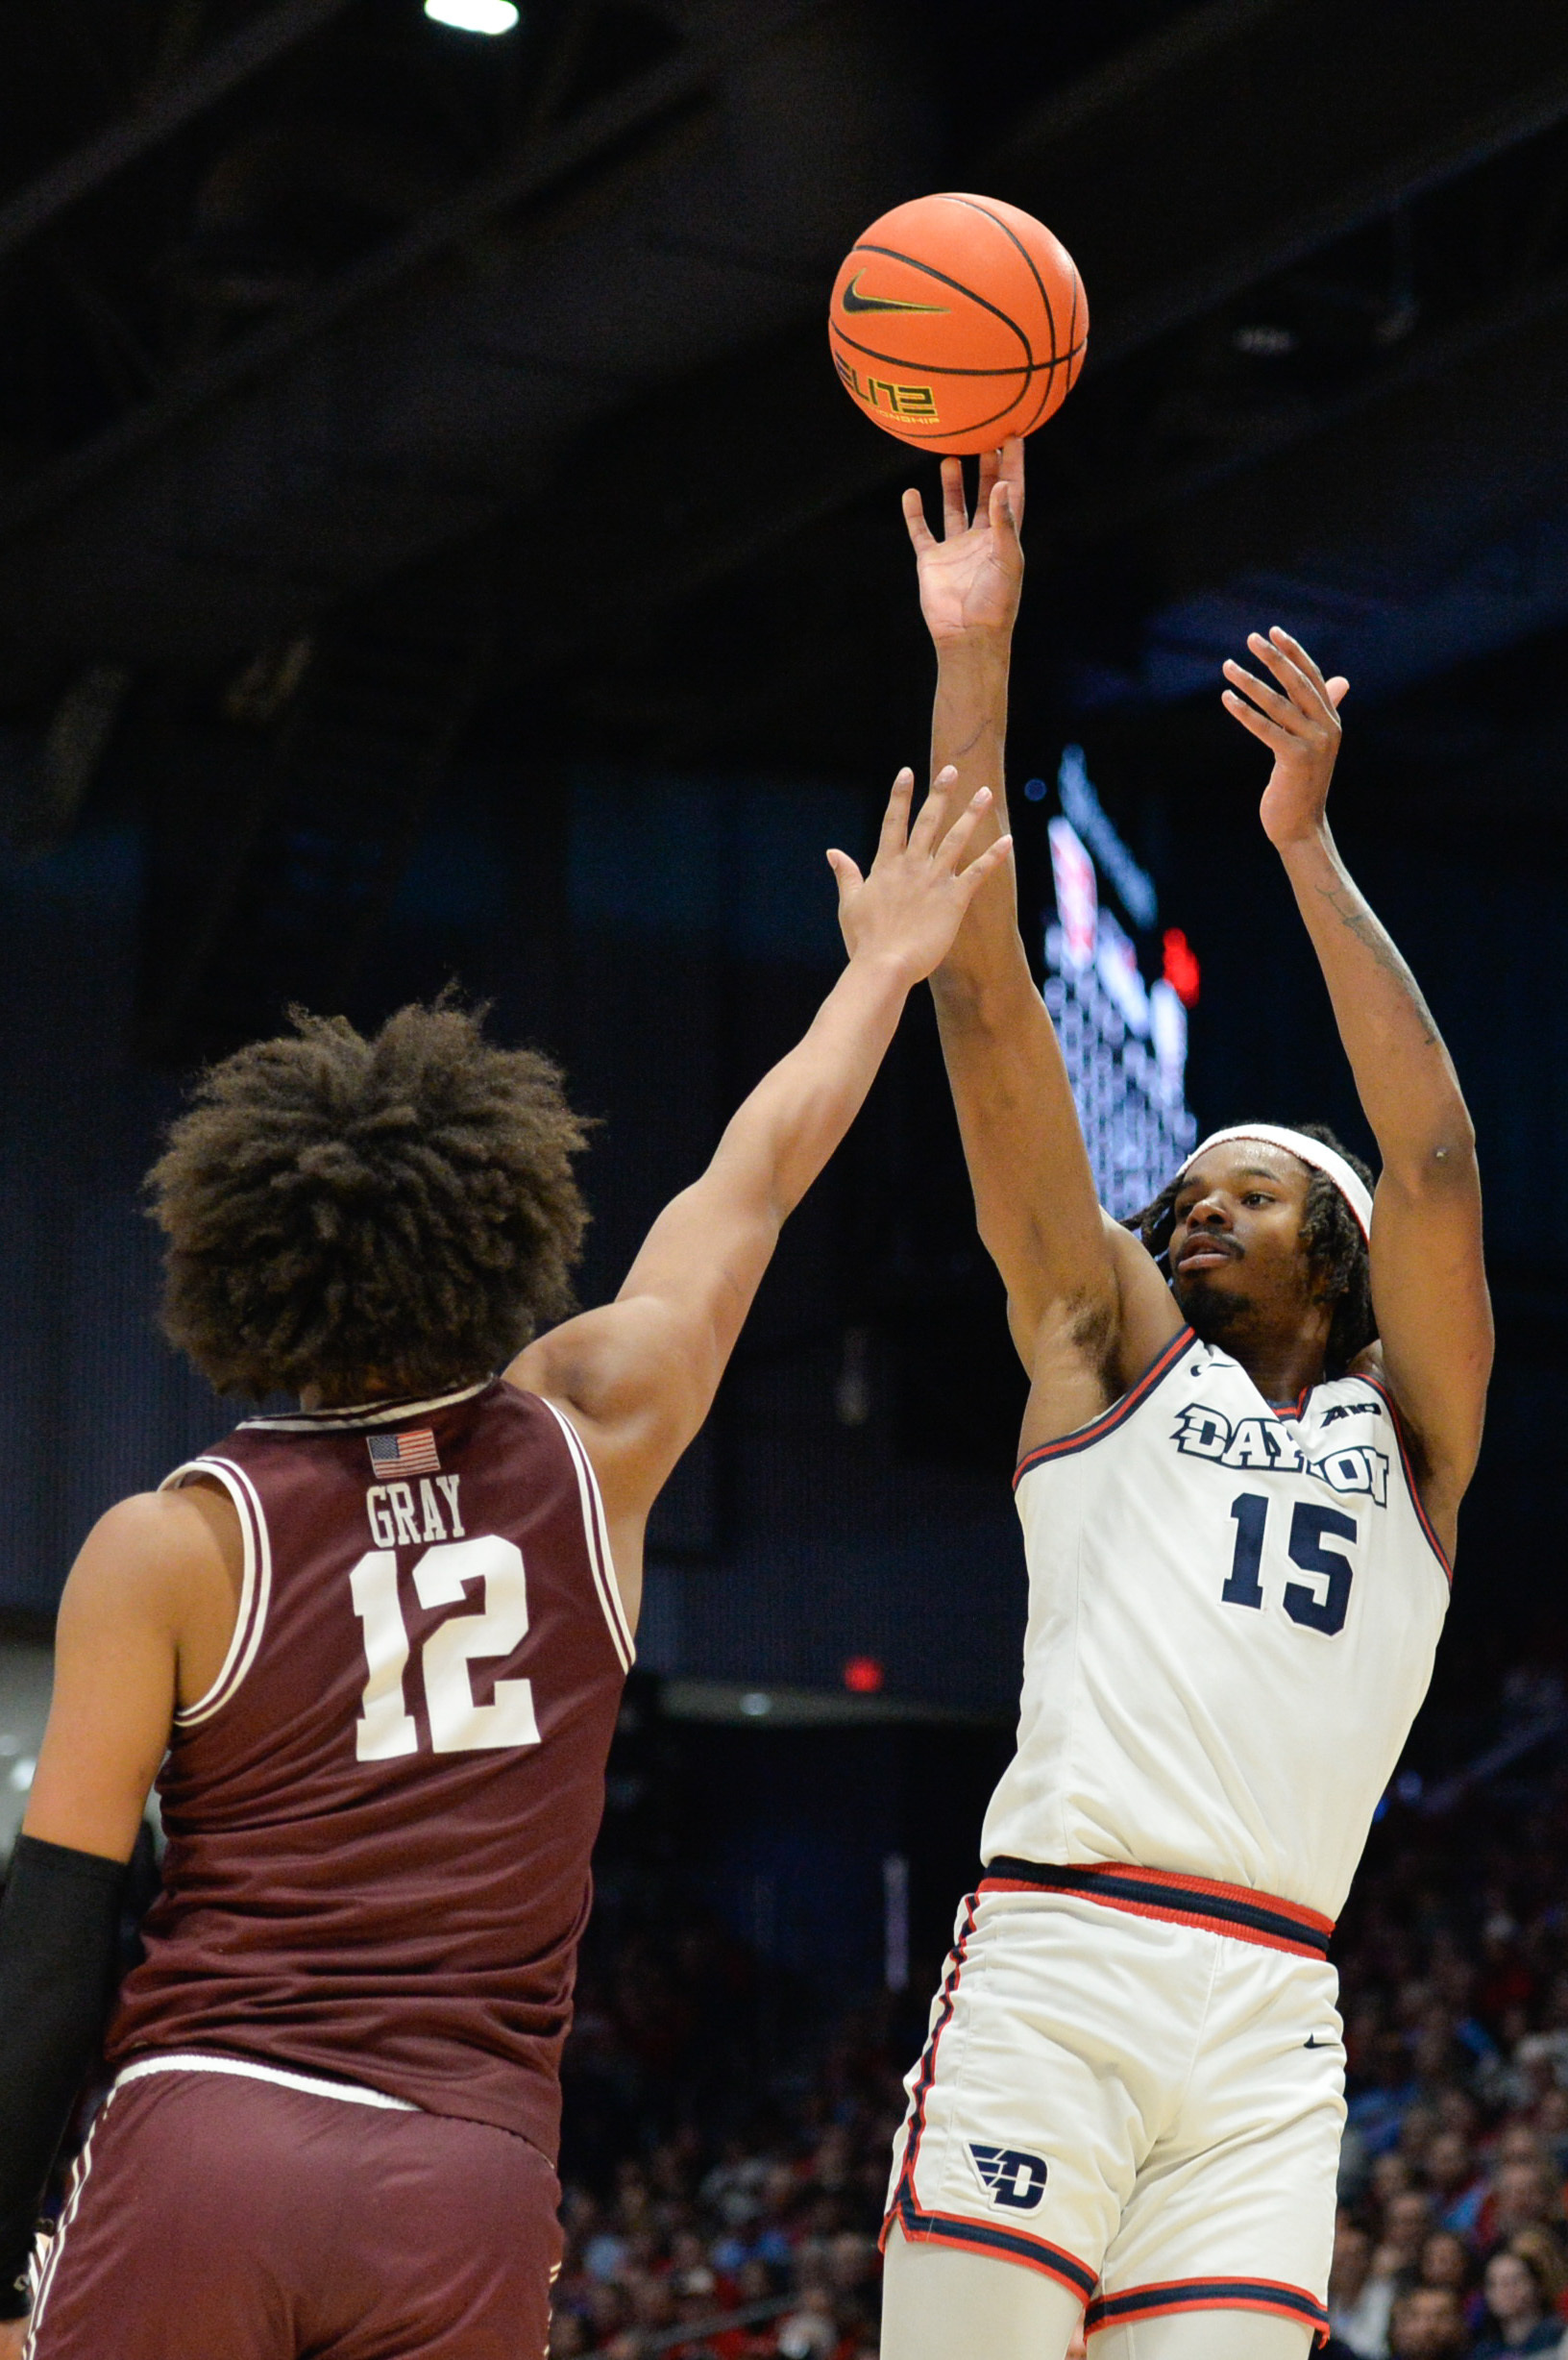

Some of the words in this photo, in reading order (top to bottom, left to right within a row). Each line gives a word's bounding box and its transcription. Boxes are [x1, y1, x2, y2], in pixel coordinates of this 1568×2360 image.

[367, 1474, 465, 1548] GRAY
[1221, 1492, 1358, 1636] 15
[349, 1534, 541, 1761] 12
